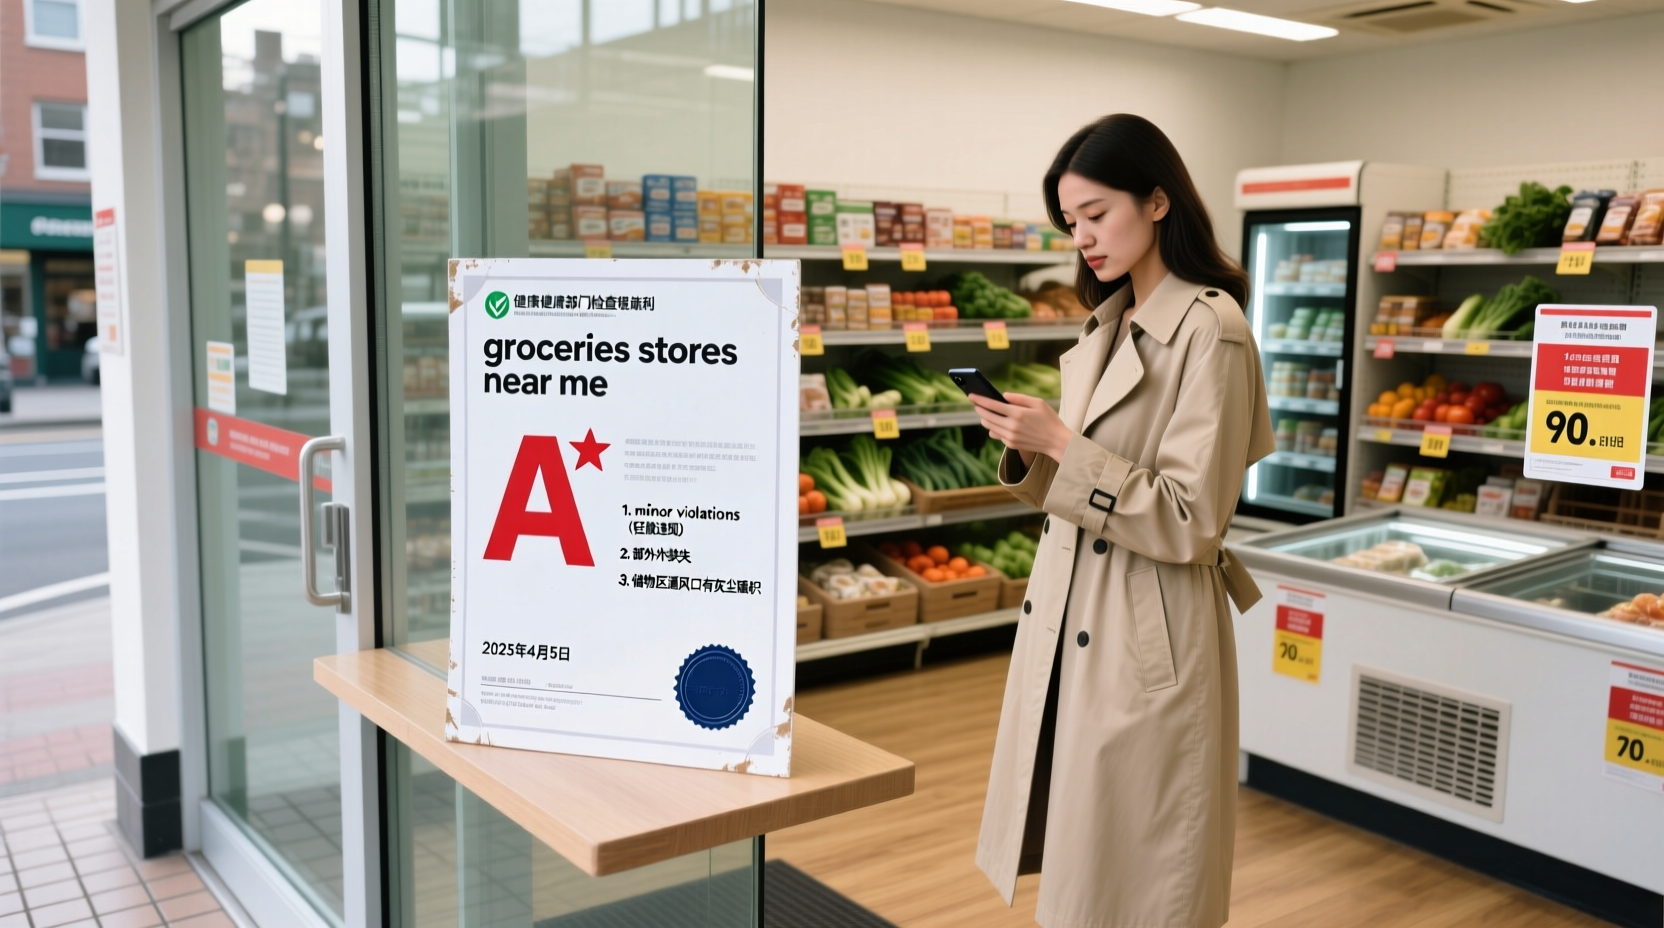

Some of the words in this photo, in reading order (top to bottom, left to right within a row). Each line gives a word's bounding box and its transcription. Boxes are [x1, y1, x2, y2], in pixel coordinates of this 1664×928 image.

[483, 333, 630, 367] groceries
[638, 336, 738, 365] stores
[484, 372, 552, 395] near
[559, 374, 608, 397] me
[483, 434, 595, 567] A
[621, 503, 631, 516] 1.
[635, 503, 673, 518] minor
[677, 505, 740, 521] violations
[618, 573, 630, 587] 3.
[481, 641, 570, 662] 2025年4月5日
